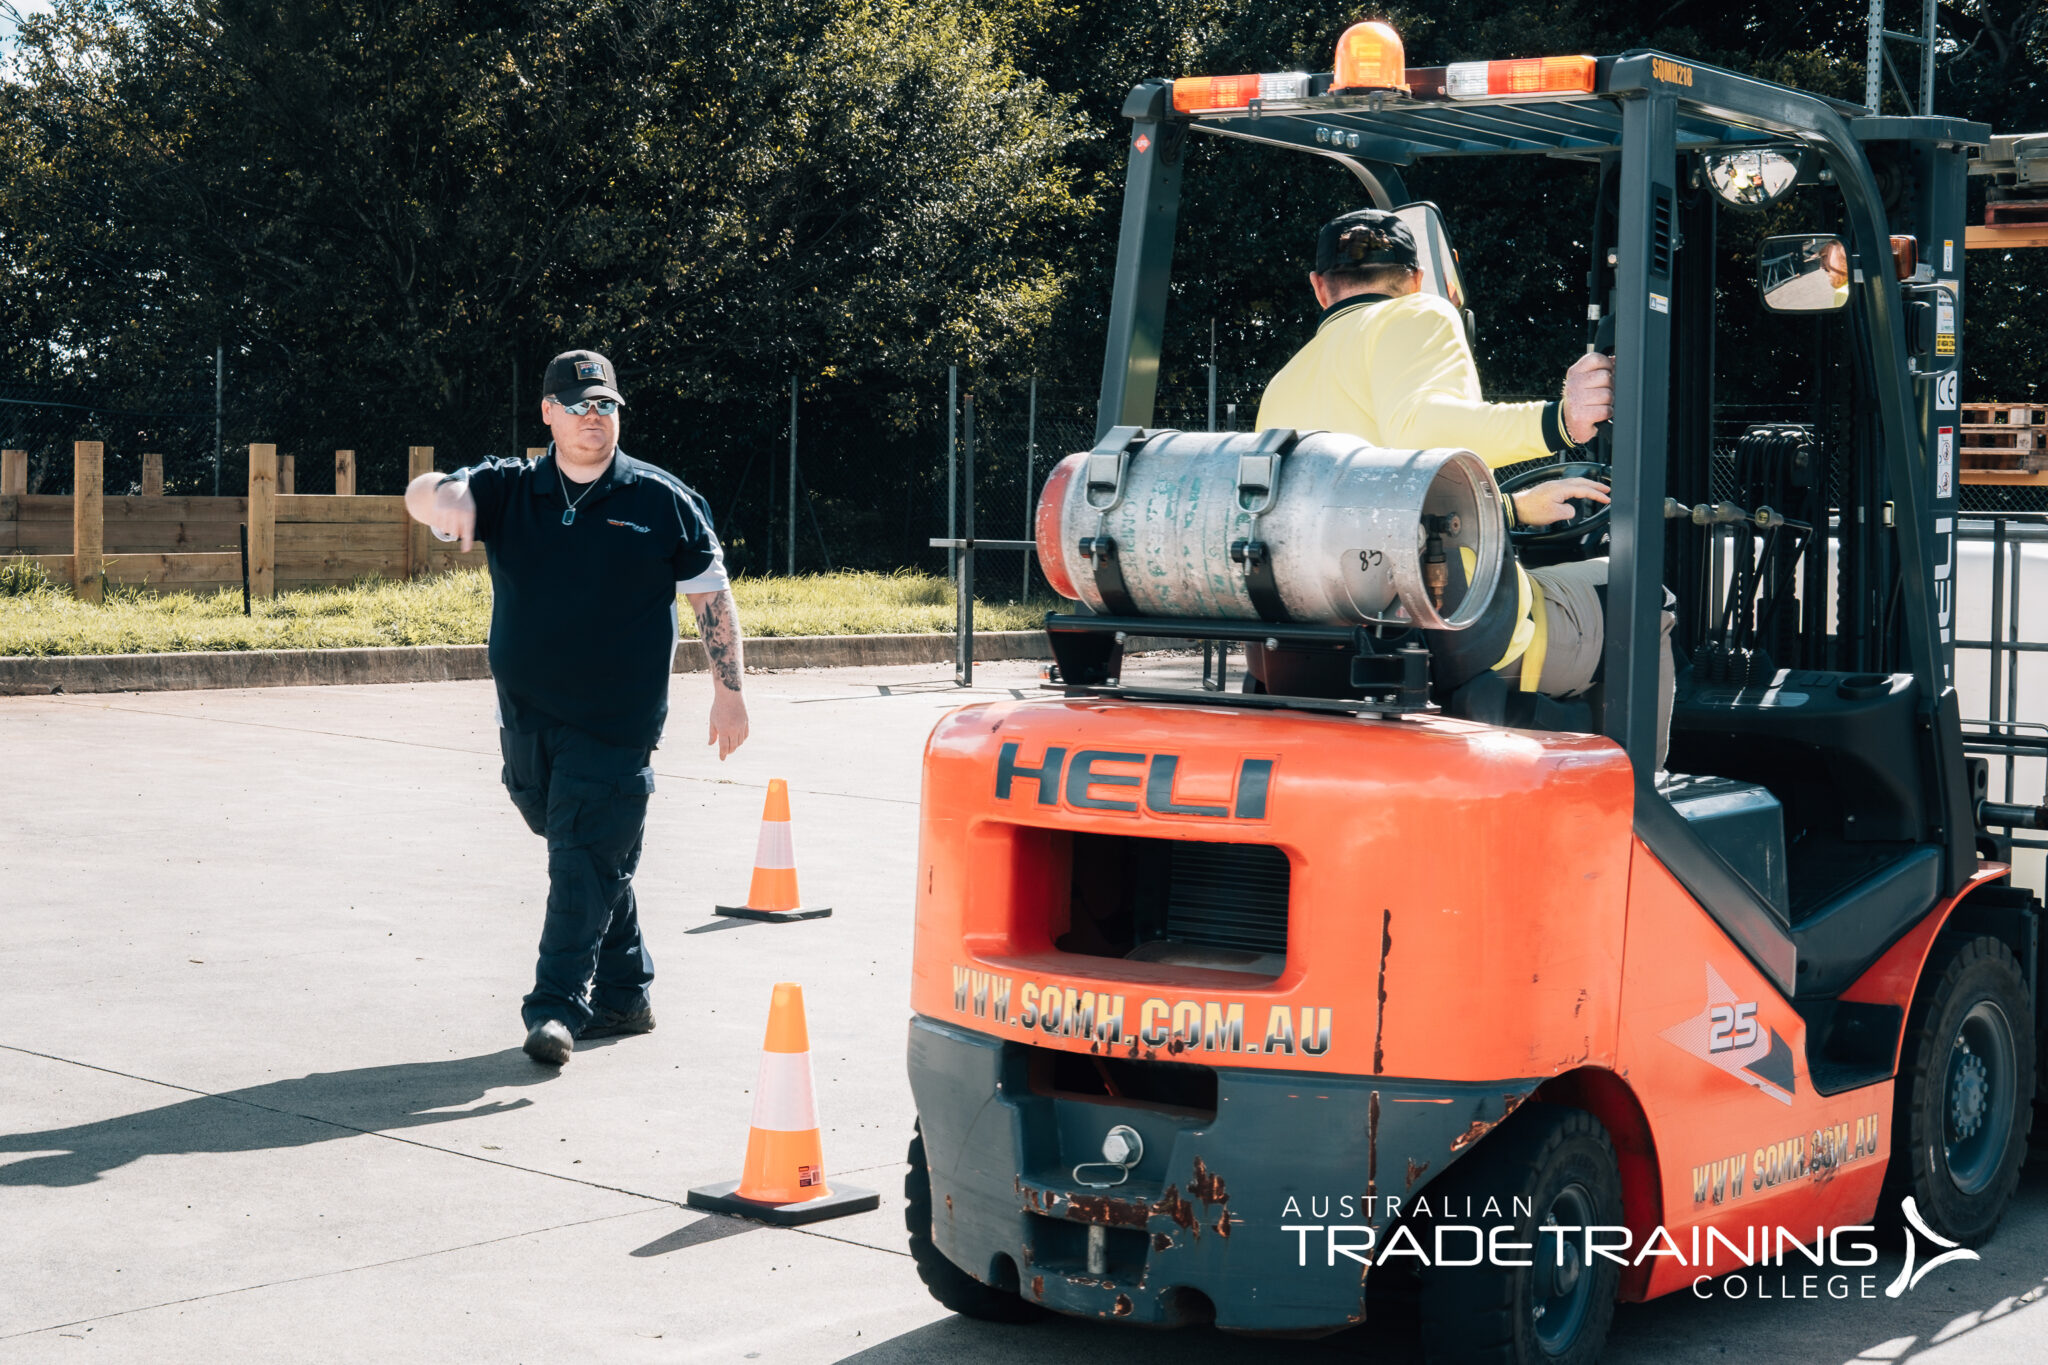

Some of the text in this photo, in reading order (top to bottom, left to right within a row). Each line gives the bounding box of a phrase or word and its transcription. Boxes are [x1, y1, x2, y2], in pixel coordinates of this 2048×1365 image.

[1652, 57, 1693, 88] SQMH218
[994, 742, 1275, 819] HELI
[952, 964, 1333, 1057] WWW.SQMH.COM.AU
[1709, 1002, 1758, 1054] 25
